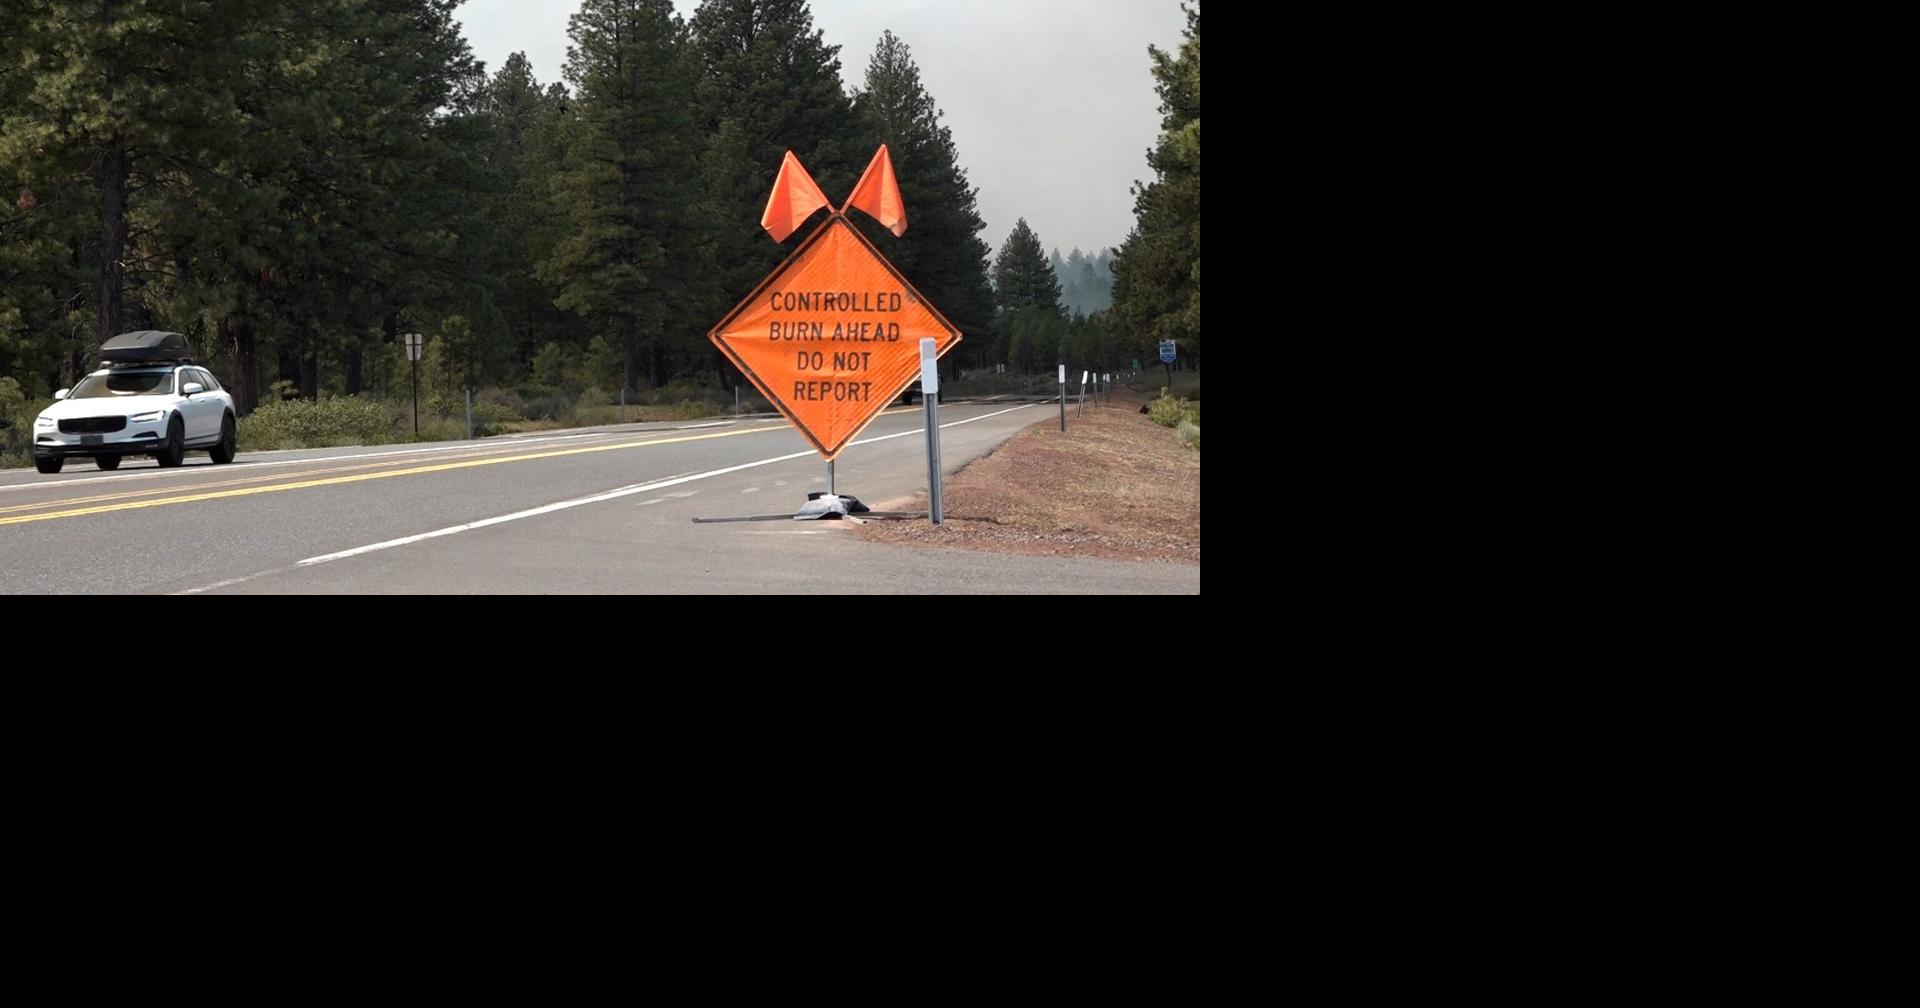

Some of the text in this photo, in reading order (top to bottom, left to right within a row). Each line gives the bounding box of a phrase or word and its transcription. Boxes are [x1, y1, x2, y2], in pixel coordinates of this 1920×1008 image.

[771, 292, 901, 312] CONTROLLED
[769, 321, 900, 342] BURN AHEAD
[797, 351, 871, 371] DO NOT
[794, 381, 872, 402] REPORT
